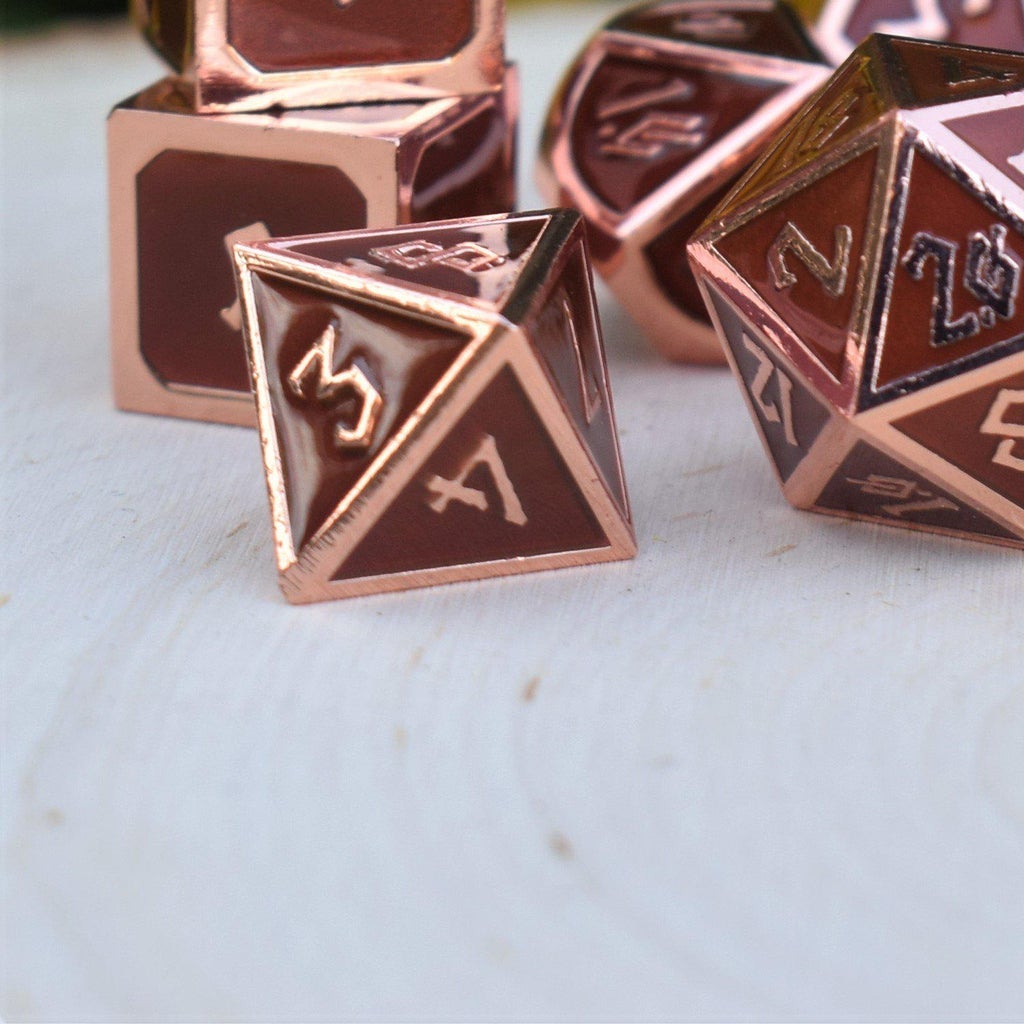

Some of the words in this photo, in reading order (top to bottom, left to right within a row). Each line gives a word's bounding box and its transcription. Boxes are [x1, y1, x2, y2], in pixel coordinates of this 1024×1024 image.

[767, 221, 853, 298] 2
[903, 223, 1023, 347] 20
[289, 322, 385, 448] 3
[424, 435, 528, 527] 4
